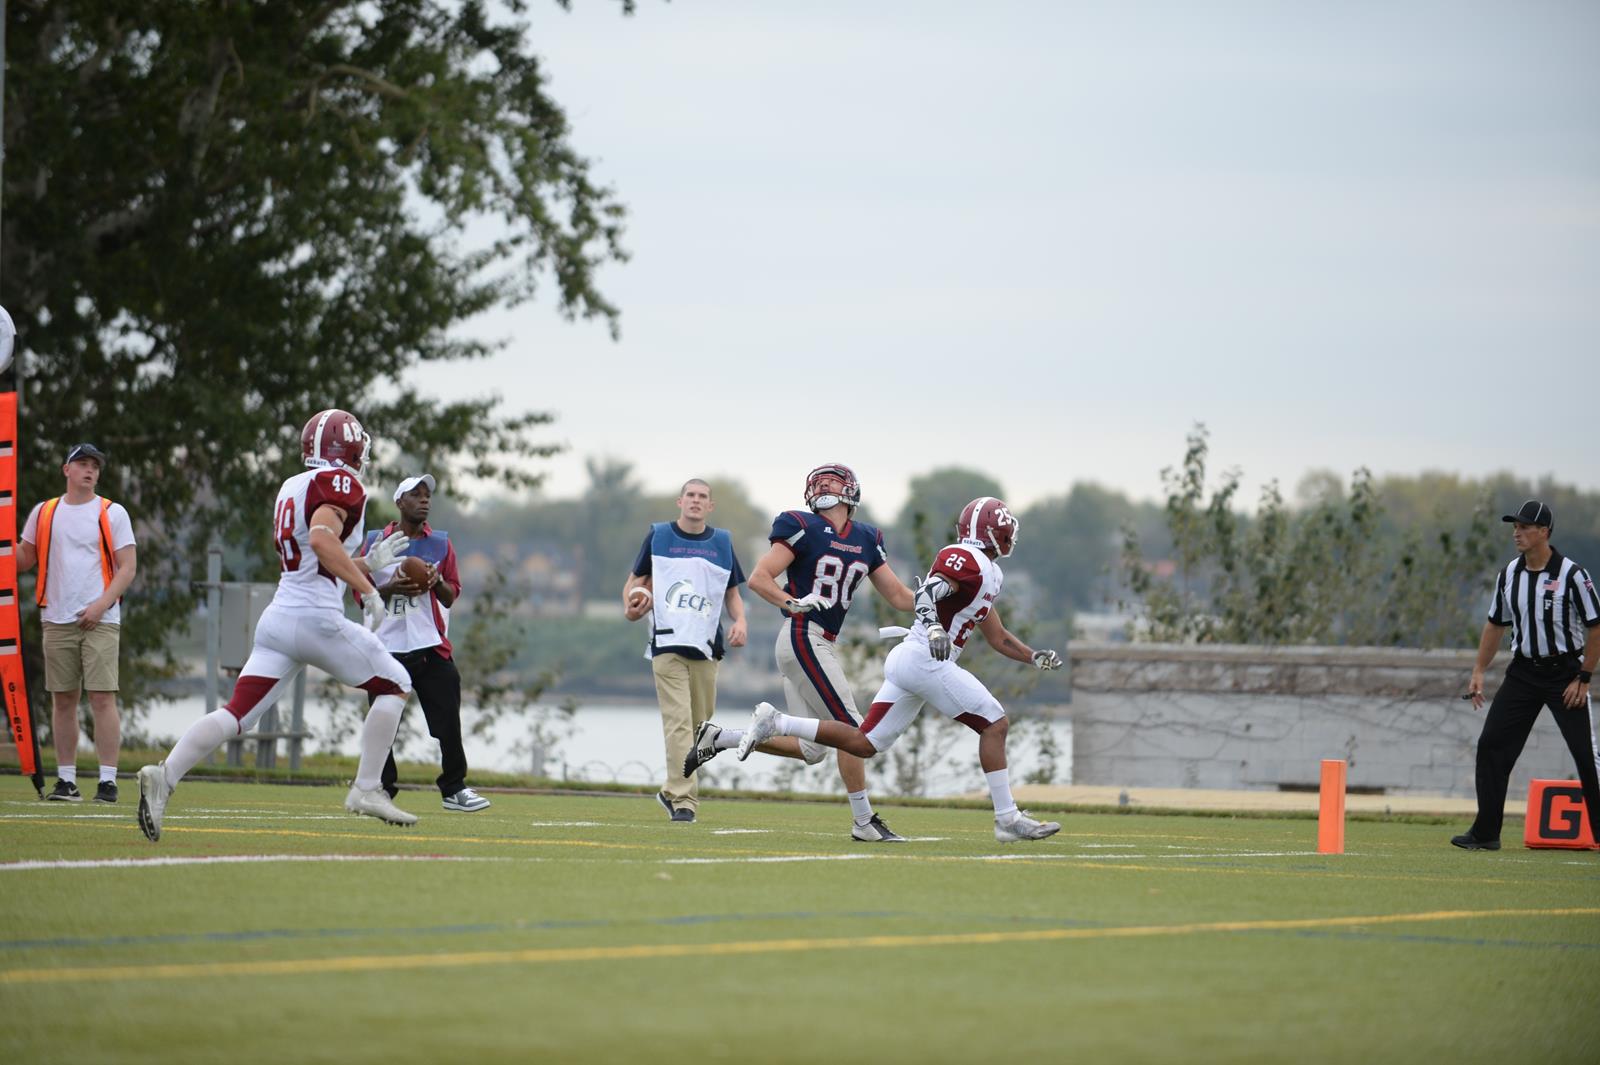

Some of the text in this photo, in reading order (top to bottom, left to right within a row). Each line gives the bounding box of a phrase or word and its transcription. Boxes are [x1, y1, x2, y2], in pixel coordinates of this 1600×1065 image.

[332, 475, 351, 494] 48
[994, 507, 1012, 526] 25
[945, 553, 966, 571] 25
[812, 554, 869, 610] 80
[1539, 786, 1583, 839] G
